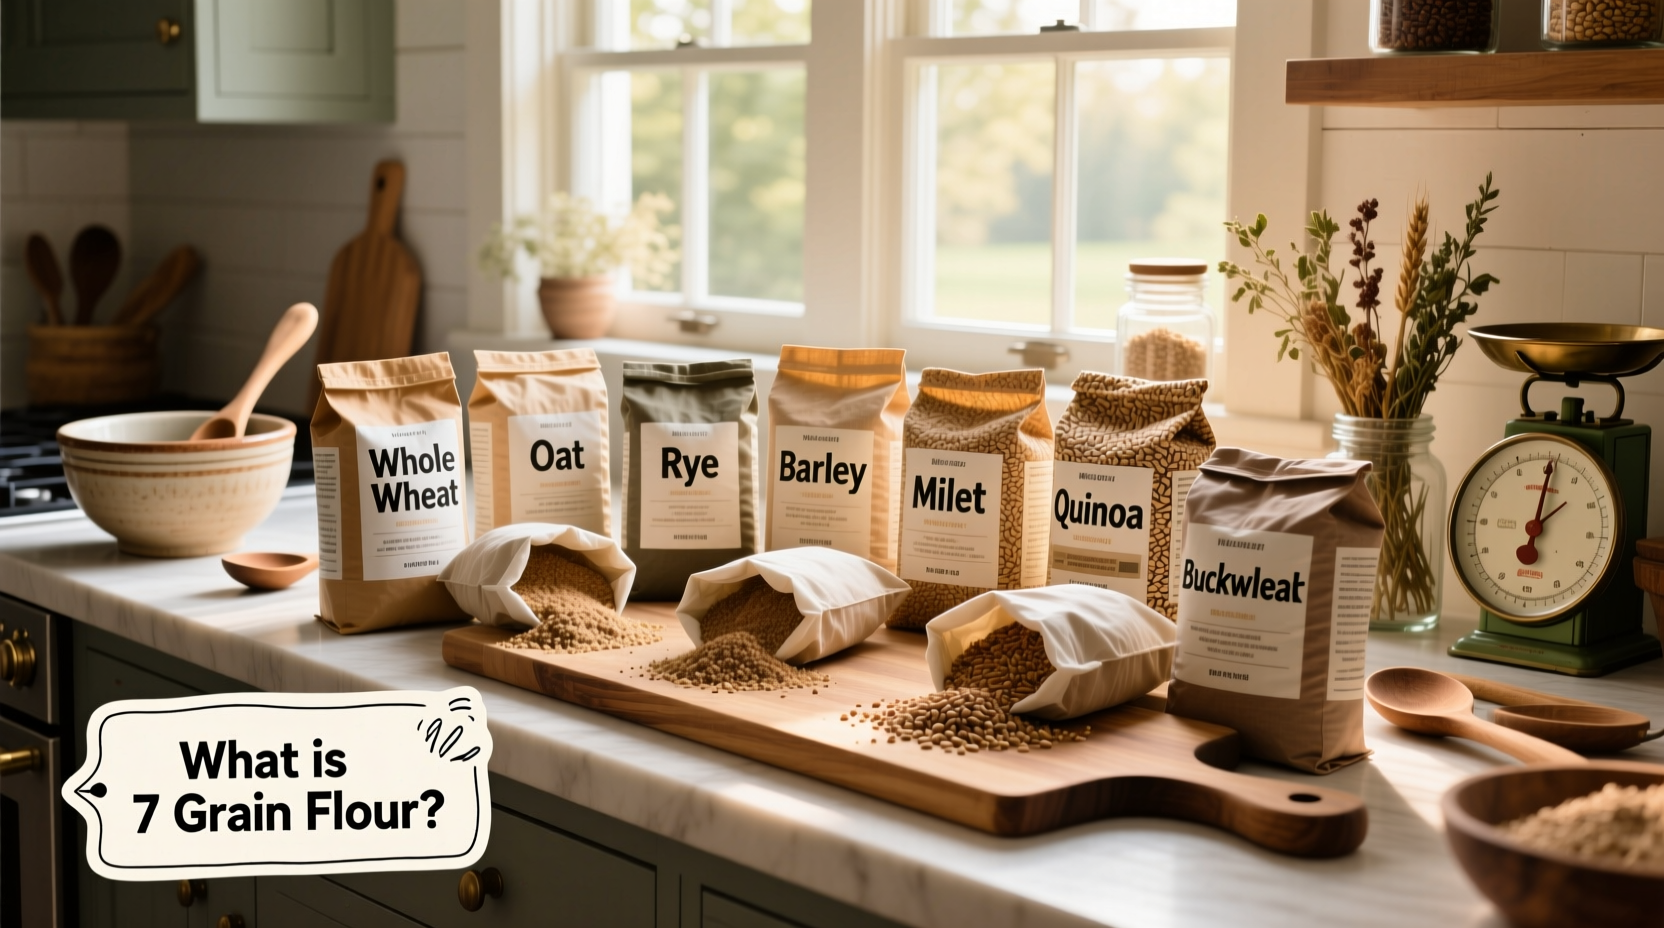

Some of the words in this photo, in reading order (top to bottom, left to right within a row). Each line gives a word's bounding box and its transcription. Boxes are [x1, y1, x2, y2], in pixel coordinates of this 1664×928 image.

[369, 443, 455, 478] Whole
[530, 439, 585, 472] Oat
[661, 447, 719, 487] Rye
[779, 450, 867, 495] Barley
[371, 479, 458, 513] Wheat
[912, 475, 986, 514] Milet
[1054, 488, 1143, 530] Quinoa
